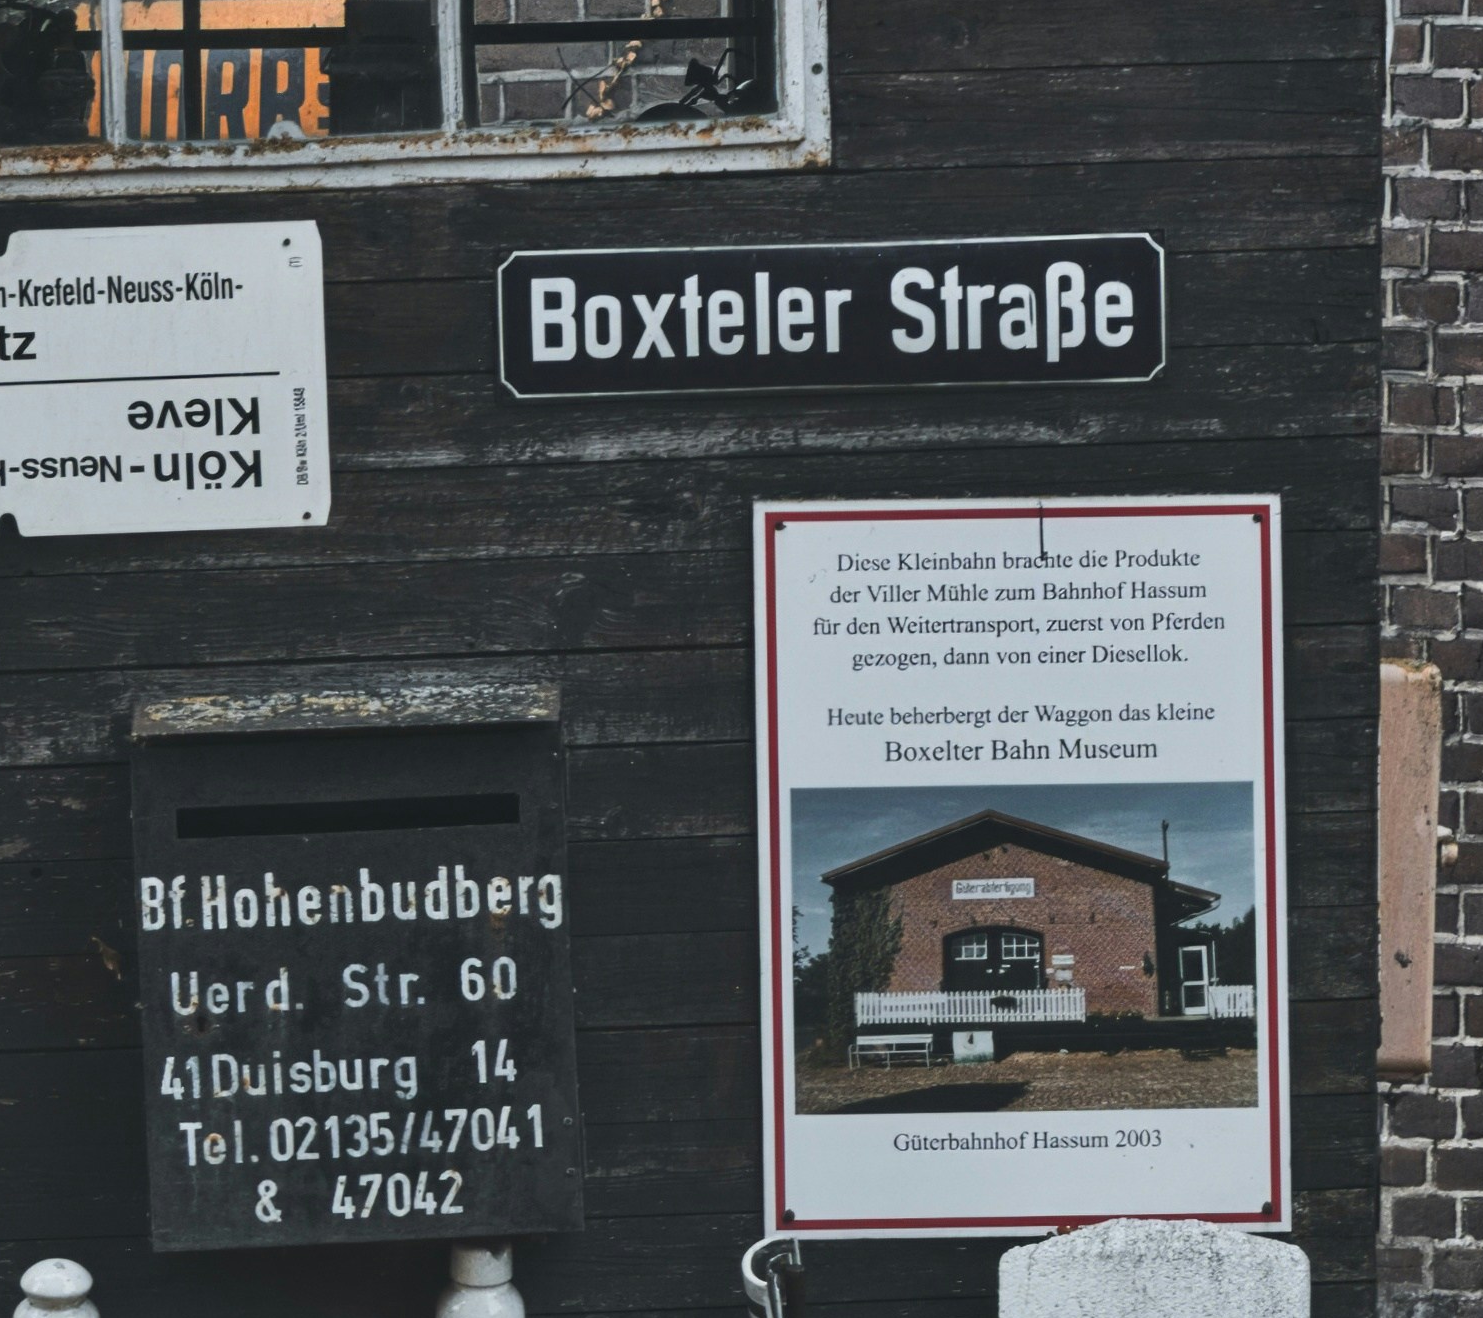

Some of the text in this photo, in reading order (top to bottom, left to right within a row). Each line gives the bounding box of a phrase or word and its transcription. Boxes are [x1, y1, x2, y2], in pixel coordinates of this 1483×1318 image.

[531, 261, 1133, 362] Boxteler Straße
[128, 397, 260, 436] Kleve
[838, 549, 1200, 571] Diese Kleinbahn brachte die Produkte
[830, 581, 1206, 603] der Viller Mühle zum Bahnhof Hassum
[814, 612, 1224, 637] für den Weitertransport, zuerst von Pferden
[853, 644, 1188, 671] gezogen, dann von einer Diesellok.
[828, 703, 1214, 728] Heute beherbergt der Waggon das kleine
[885, 739, 1157, 761] Boxelter Bahn Museum
[171, 956, 516, 1015] Uerd. Str. 60
[472, 1039, 517, 1083] 14
[894, 1130, 1161, 1151] Güterbahnhof Hassum 2003
[255, 1170, 463, 1222] & 47042
